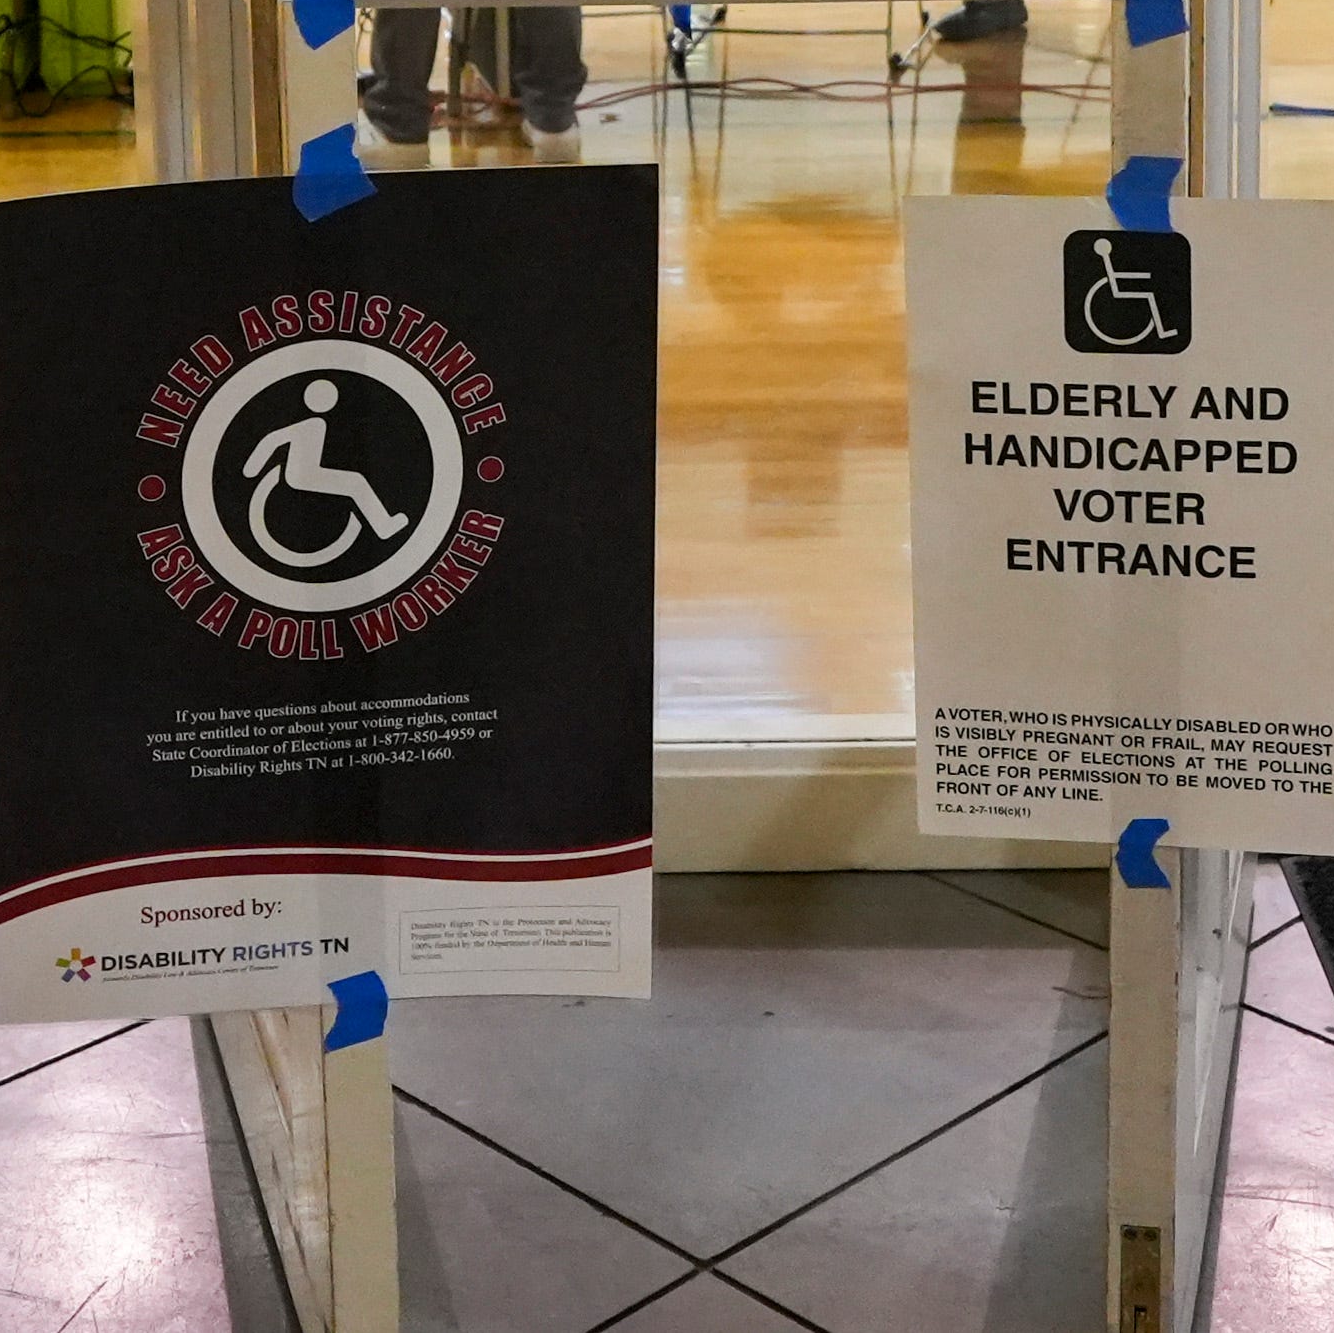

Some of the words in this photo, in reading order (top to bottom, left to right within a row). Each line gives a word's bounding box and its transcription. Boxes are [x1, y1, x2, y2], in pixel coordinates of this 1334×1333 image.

[136, 334, 234, 449] NEED
[239, 290, 506, 435] ASSISTANCE
[971, 381, 1178, 418] ELDERLY
[1190, 387, 1290, 420] AND
[964, 433, 1298, 474] HANDICAPPED
[1053, 489, 1205, 525] VOTER
[1006, 538, 1257, 578] ENTRANCE
[137, 523, 211, 610] ASK
[197, 593, 239, 636] A
[238, 610, 343, 660] POLL
[349, 510, 504, 653] WORKER
[176, 710, 189, 723] If
[191, 711, 215, 724] you
[219, 707, 251, 720] have
[255, 702, 316, 721] questions
[321, 700, 357, 712] about
[361, 692, 470, 711] accommodations
[935, 708, 946, 720] A
[1010, 712, 1048, 724] WHO
[1052, 714, 1068, 726] IS
[1071, 714, 1172, 730] PHYSICALLY
[1176, 719, 1261, 734] DISABLED
[1265, 723, 1290, 734] OR
[1292, 724, 1333, 737] WHO
[147, 733, 172, 746] you
[176, 732, 196, 741] are
[200, 725, 250, 739] entitled
[253, 726, 266, 736] to
[271, 726, 284, 735] or
[288, 721, 324, 734] about
[328, 722, 358, 733] your
[362, 716, 403, 730] voting
[407, 712, 448, 728] rights,
[451, 709, 498, 722] contact
[153, 749, 186, 761] State
[190, 741, 269, 759] Coordinator
[273, 741, 289, 752] of
[291, 736, 351, 752] Elections
[355, 738, 367, 747] at
[372, 727, 476, 747] 1-877-850-4959
[479, 730, 493, 739] or
[935, 726, 951, 738] IS
[955, 727, 1016, 741] VISIBLY
[1023, 730, 1115, 747] PREGNANT
[1121, 735, 1145, 748] OR
[1152, 737, 1205, 752] FRAIL,
[1211, 739, 1245, 752] MAY
[1253, 740, 1334, 756] REQUEST
[191, 762, 255, 777] Disability
[260, 760, 302, 775] Rights
[307, 757, 327, 769] TN
[332, 758, 344, 767] at
[349, 748, 455, 766] 1-800-342-1660.
[935, 745, 968, 757] THE
[978, 746, 1038, 761] OFFICE
[1049, 750, 1071, 762] OF
[1081, 752, 1176, 768] ELECTIONS
[1185, 757, 1206, 769] AT
[1215, 758, 1248, 771] THE
[1258, 760, 1333, 775] POLLING
[936, 763, 990, 777] PLACE
[997, 766, 1031, 778] FOR
[1038, 768, 1141, 784] PERMISSION
[1146, 773, 1169, 786] TO
[1176, 775, 1199, 787] BE
[1205, 776, 1266, 790] MOVED
[1271, 779, 1294, 792] TO
[1299, 781, 1333, 794] THE
[936, 782, 992, 795] FRONT
[996, 784, 1020, 796] OF
[1023, 786, 1057, 798] ANY
[1062, 788, 1104, 801] LINE.
[140, 899, 247, 927] Sponsored
[251, 898, 283, 922] by:
[101, 947, 226, 973] DISABILITY
[232, 940, 314, 963] RIGHTS
[320, 937, 350, 956] TN
